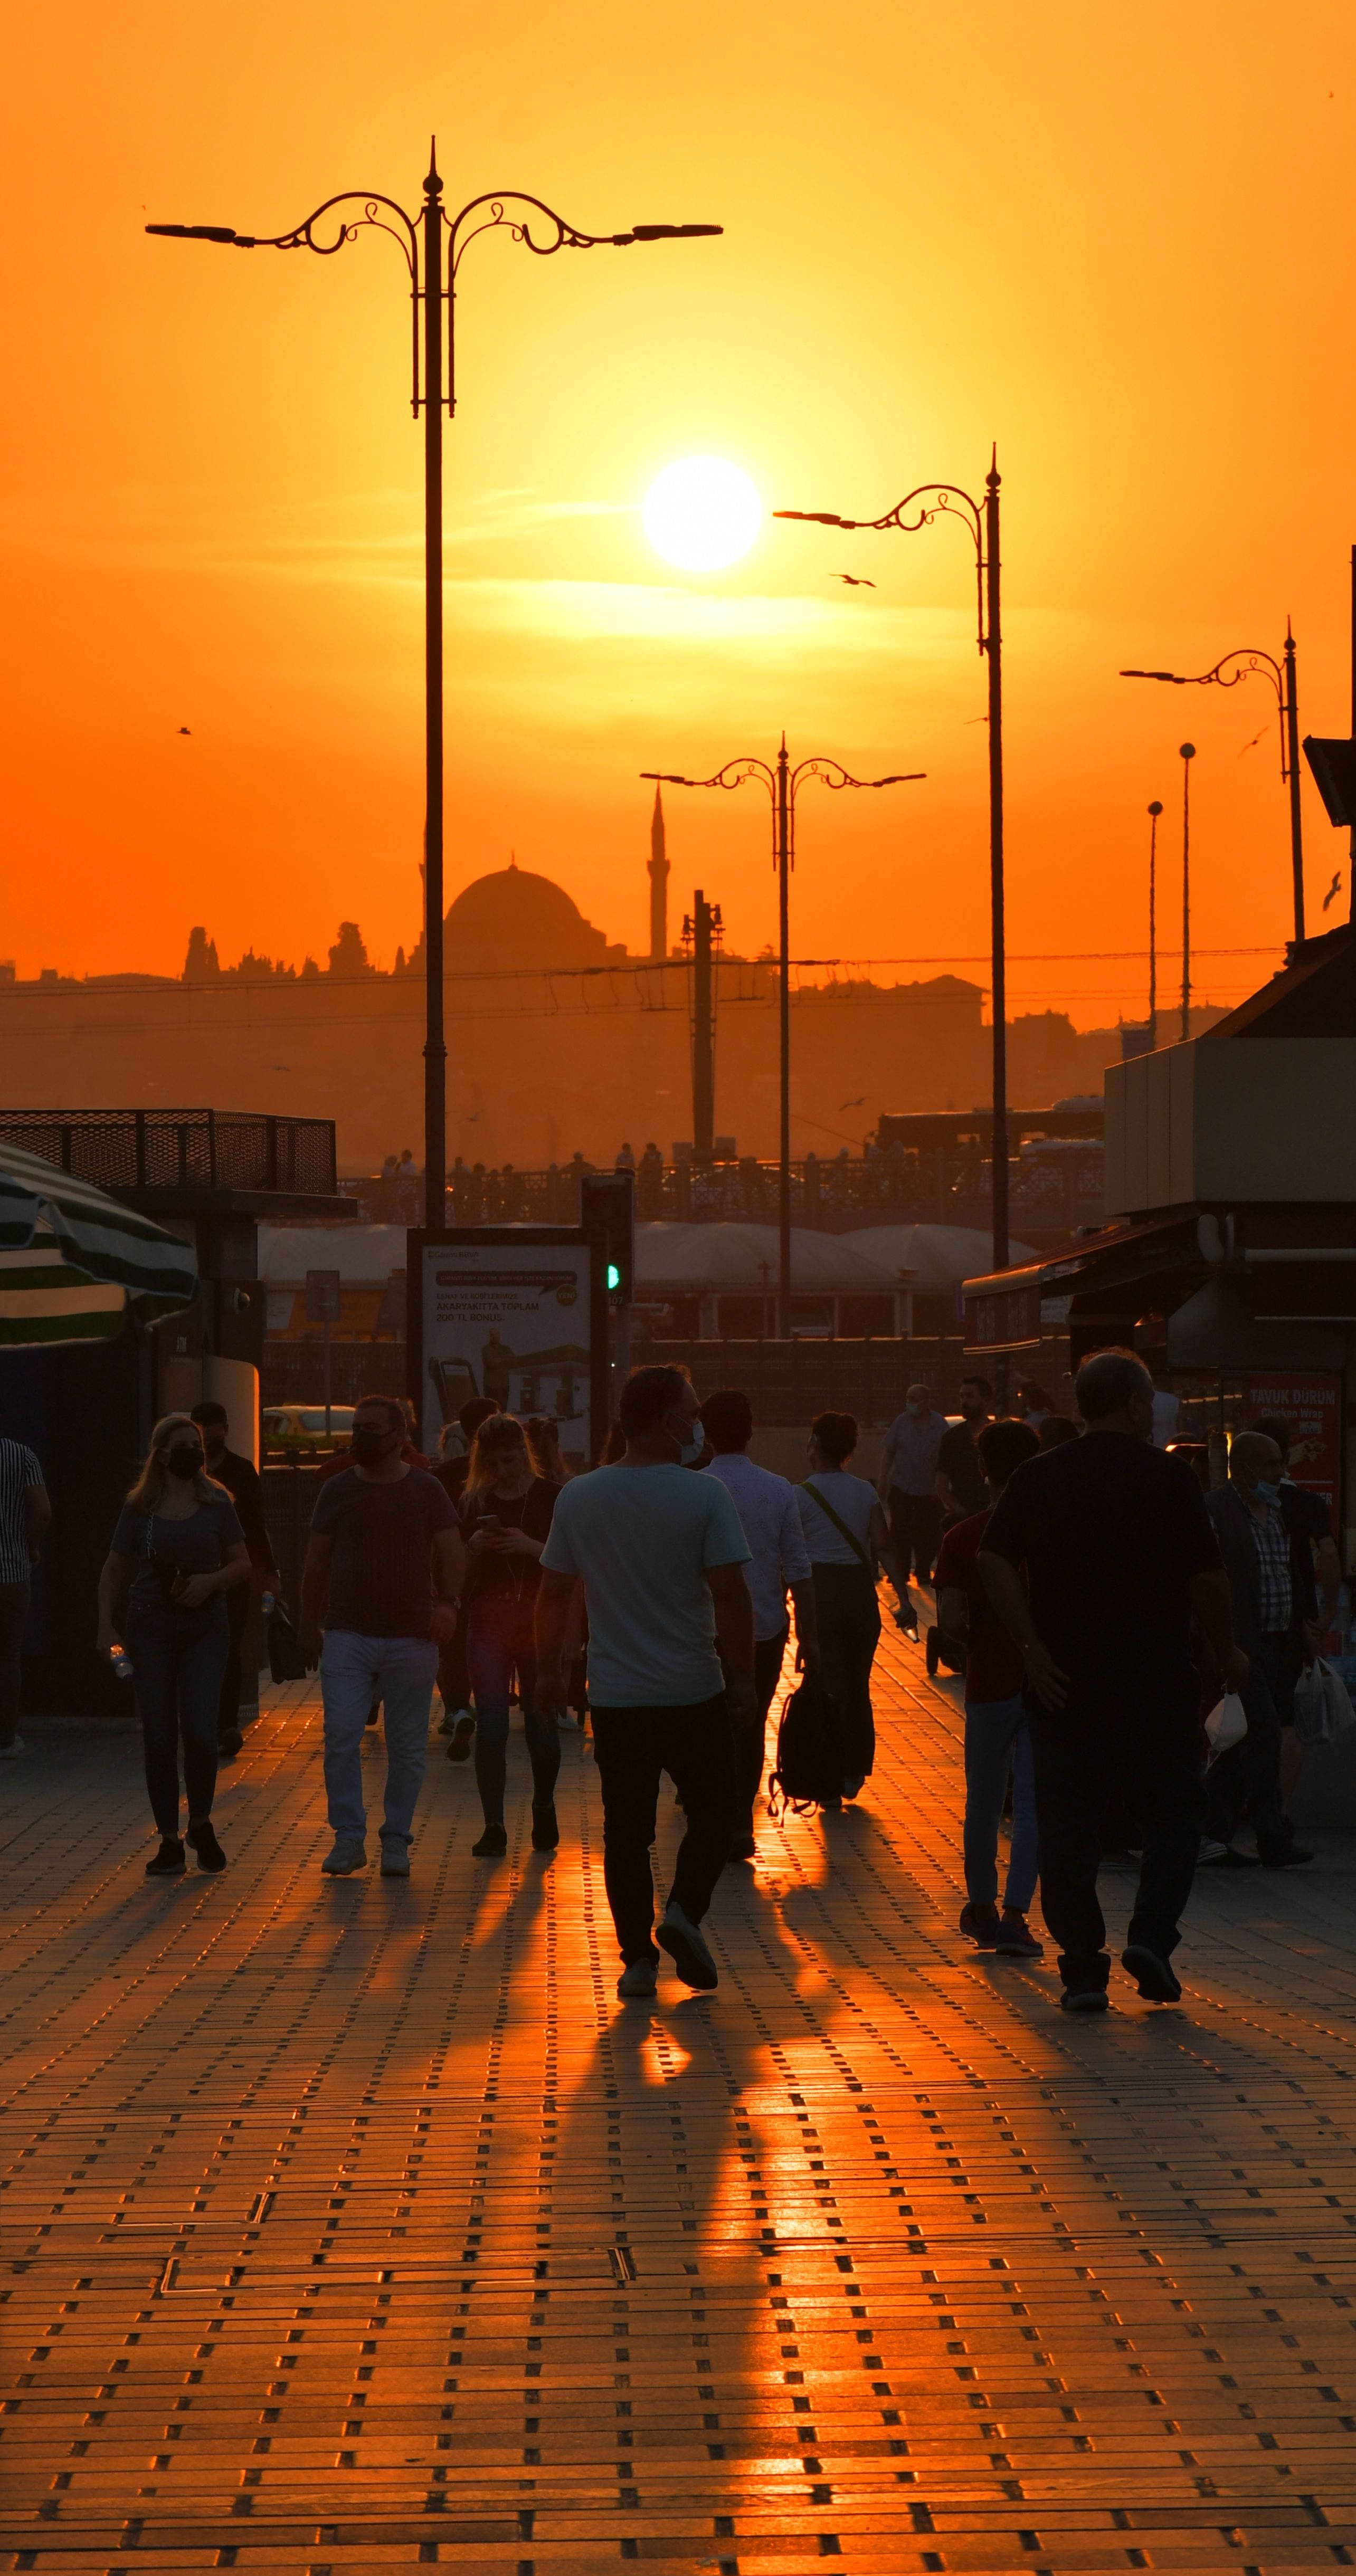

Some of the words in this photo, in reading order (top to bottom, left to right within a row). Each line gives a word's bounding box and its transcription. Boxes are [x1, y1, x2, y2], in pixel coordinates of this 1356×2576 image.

[1250, 1388, 1289, 1404] TAVUK
[1292, 1387, 1335, 1405] DÜRÜM
[1261, 1407, 1297, 1417] Chicken
[1300, 1408, 1324, 1420] Wrap
